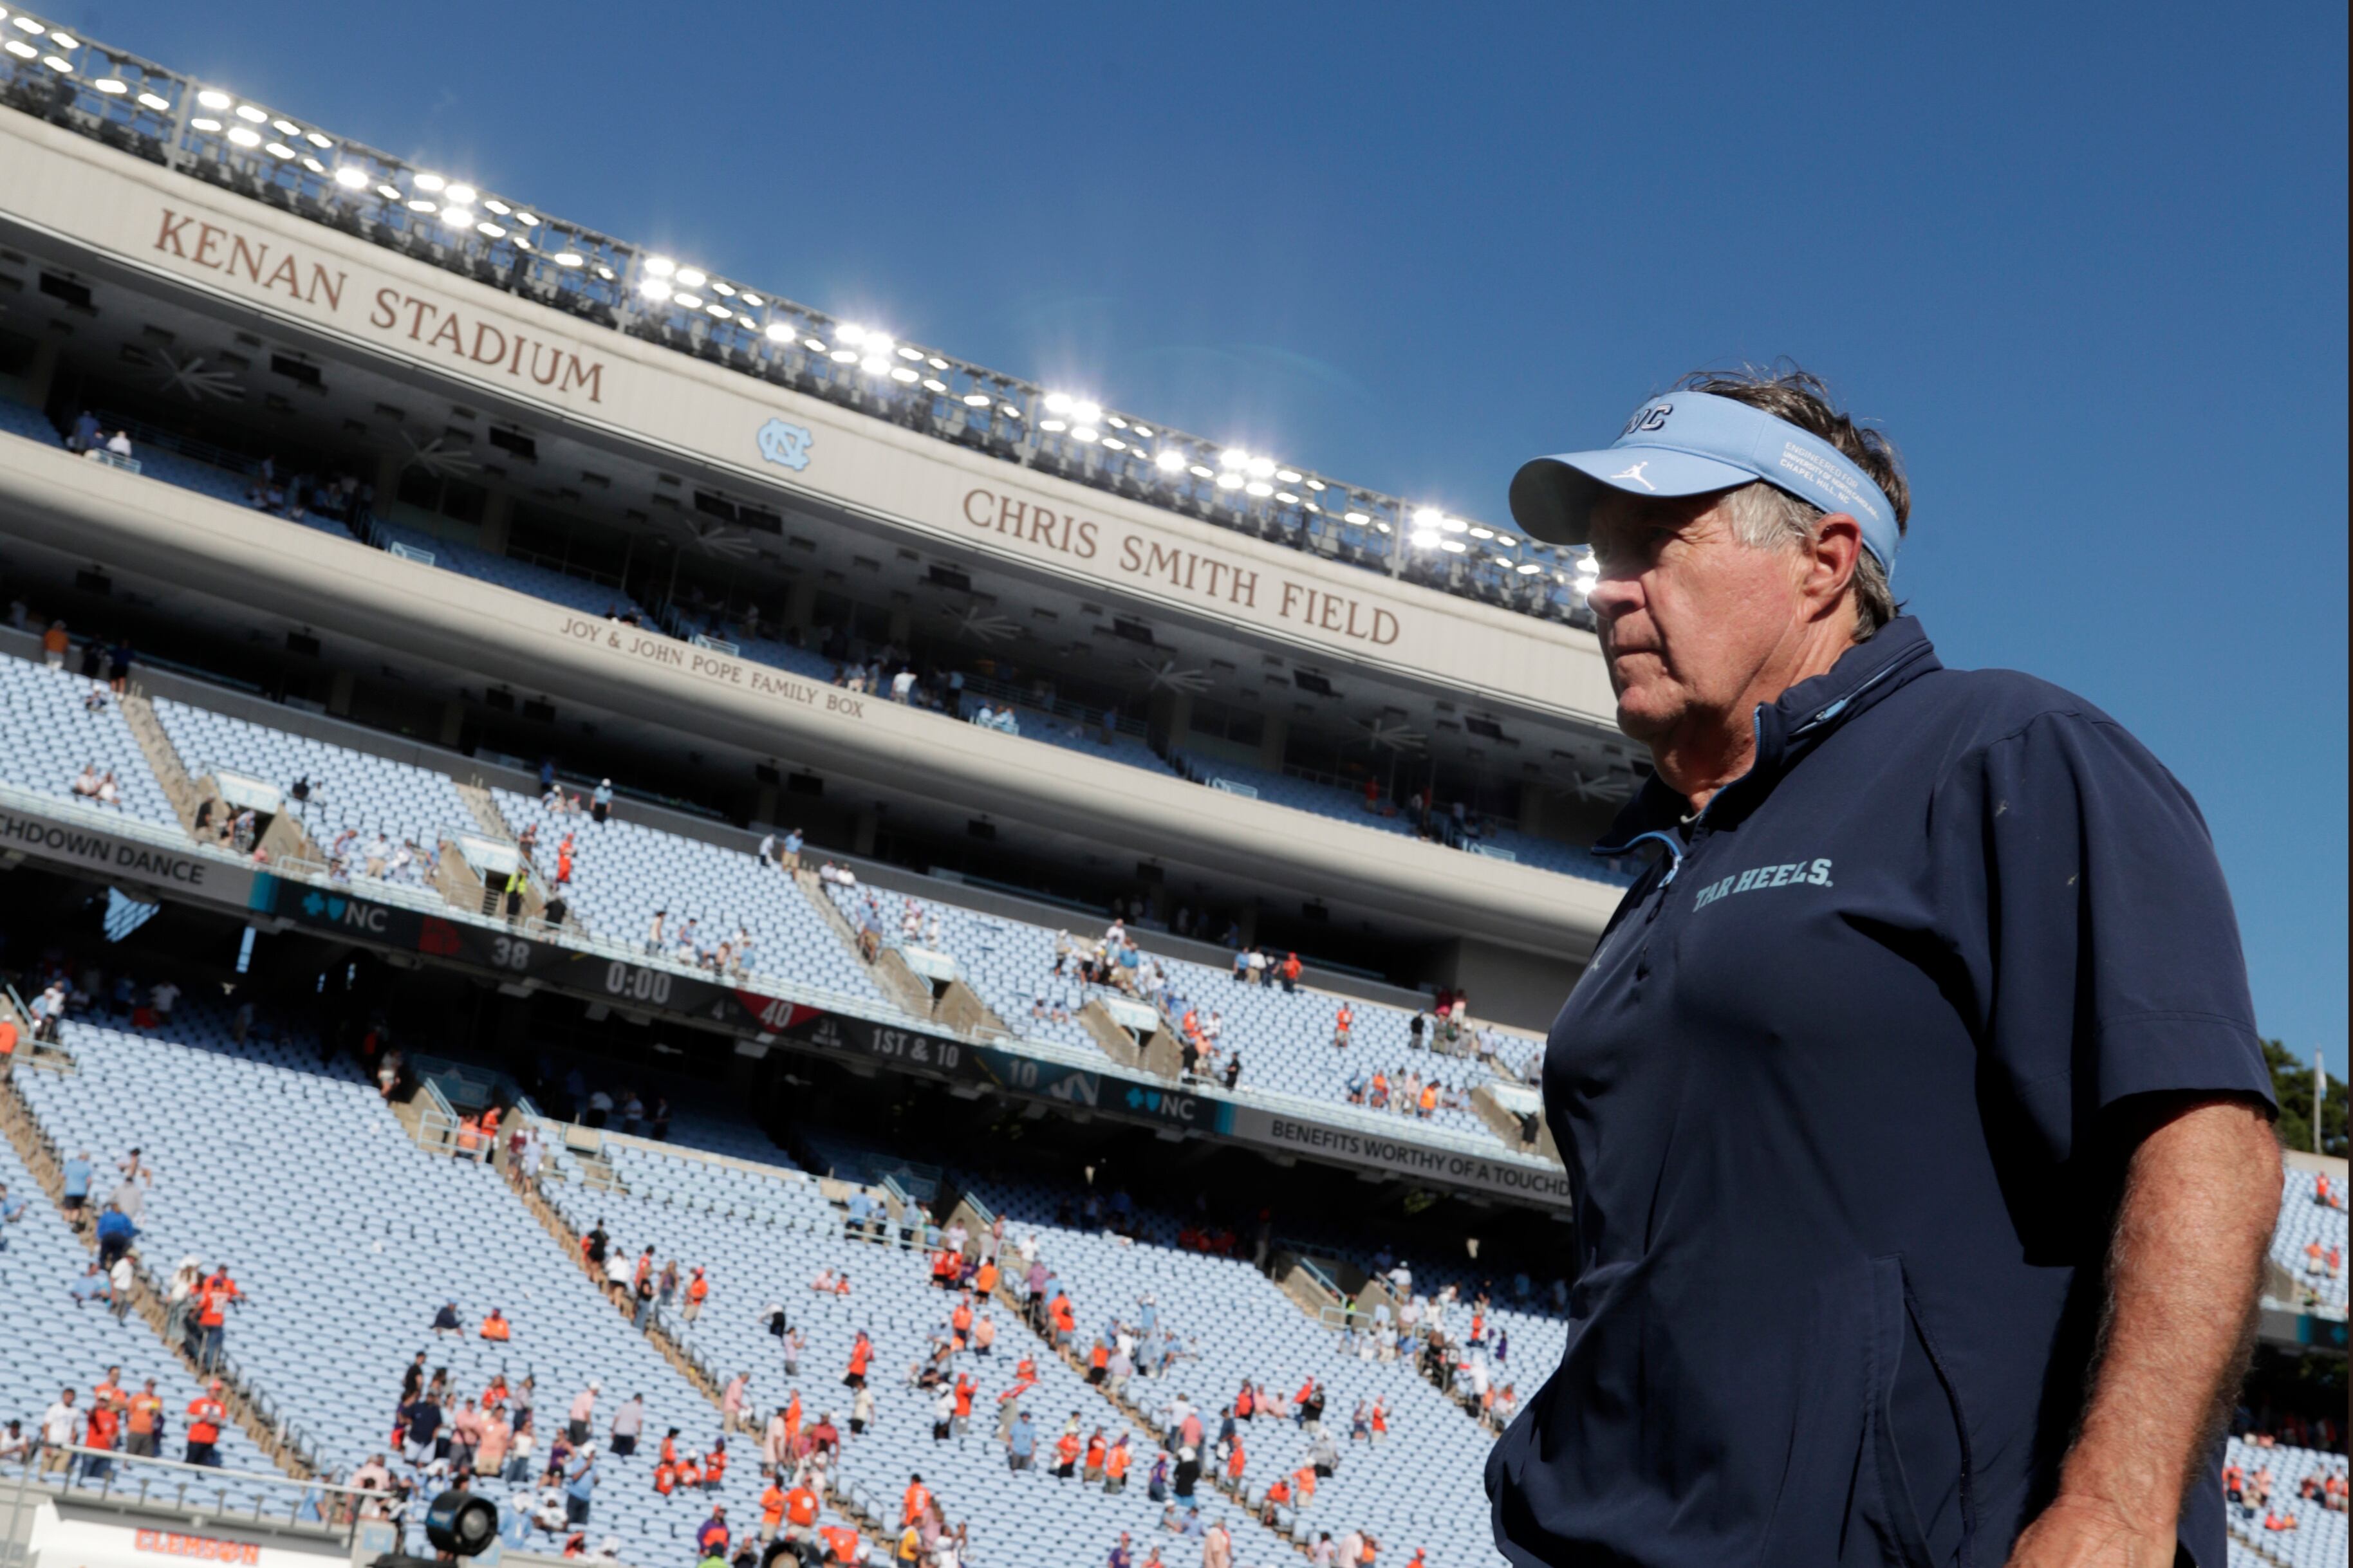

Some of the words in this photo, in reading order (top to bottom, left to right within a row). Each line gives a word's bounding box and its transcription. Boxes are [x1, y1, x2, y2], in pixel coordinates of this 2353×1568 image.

[154, 209, 348, 311] KENAN
[370, 288, 604, 403] STADIUM
[1621, 403, 1673, 436] NC
[1780, 458, 1815, 482] CHAPEL
[1816, 479, 1837, 496] HILL,
[1837, 492, 1850, 504] NC
[1782, 450, 1823, 476] UNIVERSITY
[1822, 471, 1832, 481] OF
[1785, 441, 1842, 477] ENGINEERED
[1842, 473, 1859, 489] FOR
[963, 488, 1098, 558] CHRIS
[1120, 535, 1259, 607] SMITH
[1279, 580, 1399, 645] FIELD
[560, 618, 601, 641] JOY
[608, 631, 620, 649] &
[628, 638, 684, 666] JOHN
[692, 655, 742, 683] POPE
[751, 672, 819, 705] FAMILY
[826, 694, 864, 718] BOX
[116, 845, 206, 885] DANCE
[1693, 875, 1735, 912] TAR
[1733, 858, 1832, 894] HEELS
[345, 902, 387, 932] NC
[491, 936, 531, 970] 38
[606, 961, 671, 1004] 0:00
[761, 999, 794, 1028] 40
[873, 1028, 911, 1054] 1ST
[911, 1038, 929, 1062] &
[937, 1043, 960, 1068] 10
[1009, 1060, 1038, 1088] 10
[1161, 1094, 1196, 1120] NC
[1272, 1120, 1359, 1154] BENEFITS
[1364, 1139, 1446, 1172] WORTHY
[1449, 1158, 1475, 1177] OF
[1476, 1166, 1491, 1181] A
[135, 1529, 260, 1565] CLEMSON
